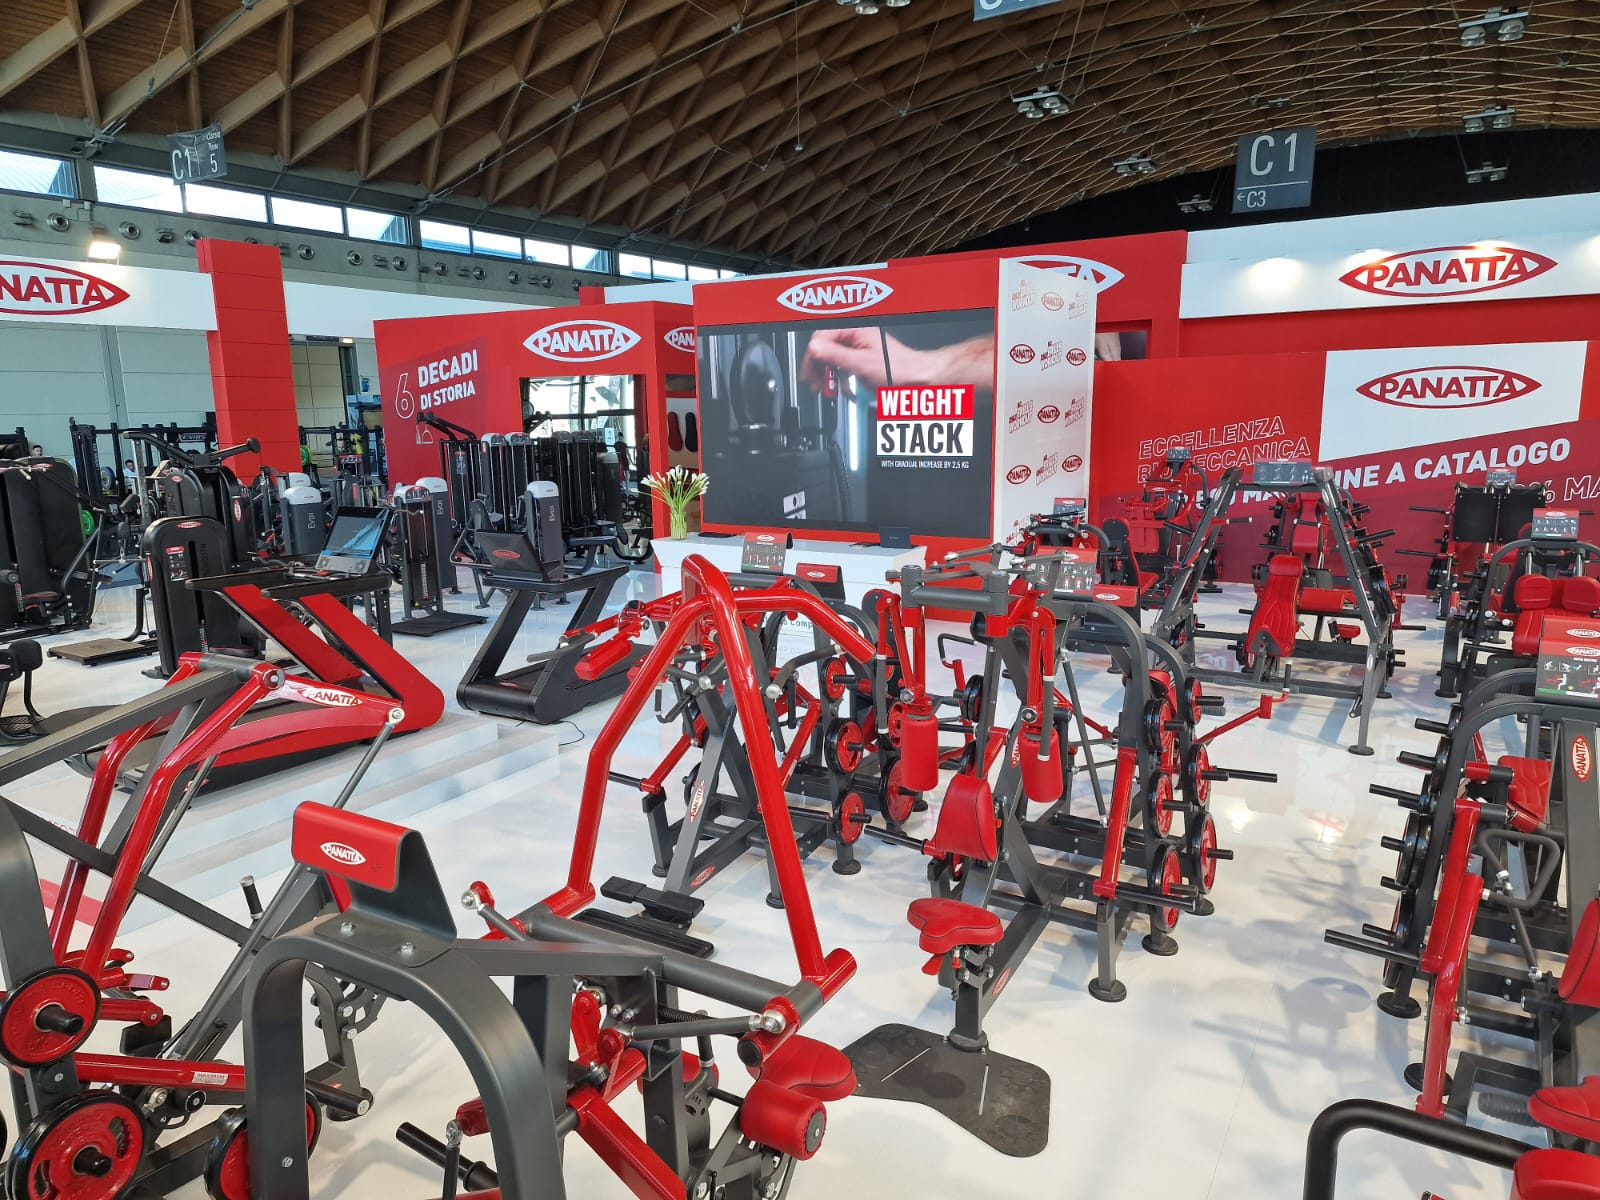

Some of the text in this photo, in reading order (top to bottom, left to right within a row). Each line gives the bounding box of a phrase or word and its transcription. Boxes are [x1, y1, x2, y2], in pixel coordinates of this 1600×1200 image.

[171, 148, 192, 180] C1
[210, 153, 218, 173] 5
[1249, 132, 1298, 176] C1
[1246, 190, 1267, 208] C3
[1366, 253, 1530, 288] PANATTA
[791, 282, 879, 307] PANATTA
[538, 328, 626, 353] PANATTA
[417, 349, 479, 388] DECADI
[395, 372, 416, 419] 6
[420, 380, 476, 410] DI STORIA
[881, 388, 966, 416] WEIGHT
[1379, 374, 1520, 399] PANATTA
[880, 422, 964, 454] STACK
[1138, 415, 1285, 460] ECCELLENZA
[1137, 437, 1311, 483] BECCANICA
[1385, 461, 1406, 484] A
[1414, 438, 1571, 480] CATALOGO
[308, 689, 360, 706] ANATTA
[1575, 739, 1588, 777] PANATTA
[325, 844, 362, 863] PANATTA
